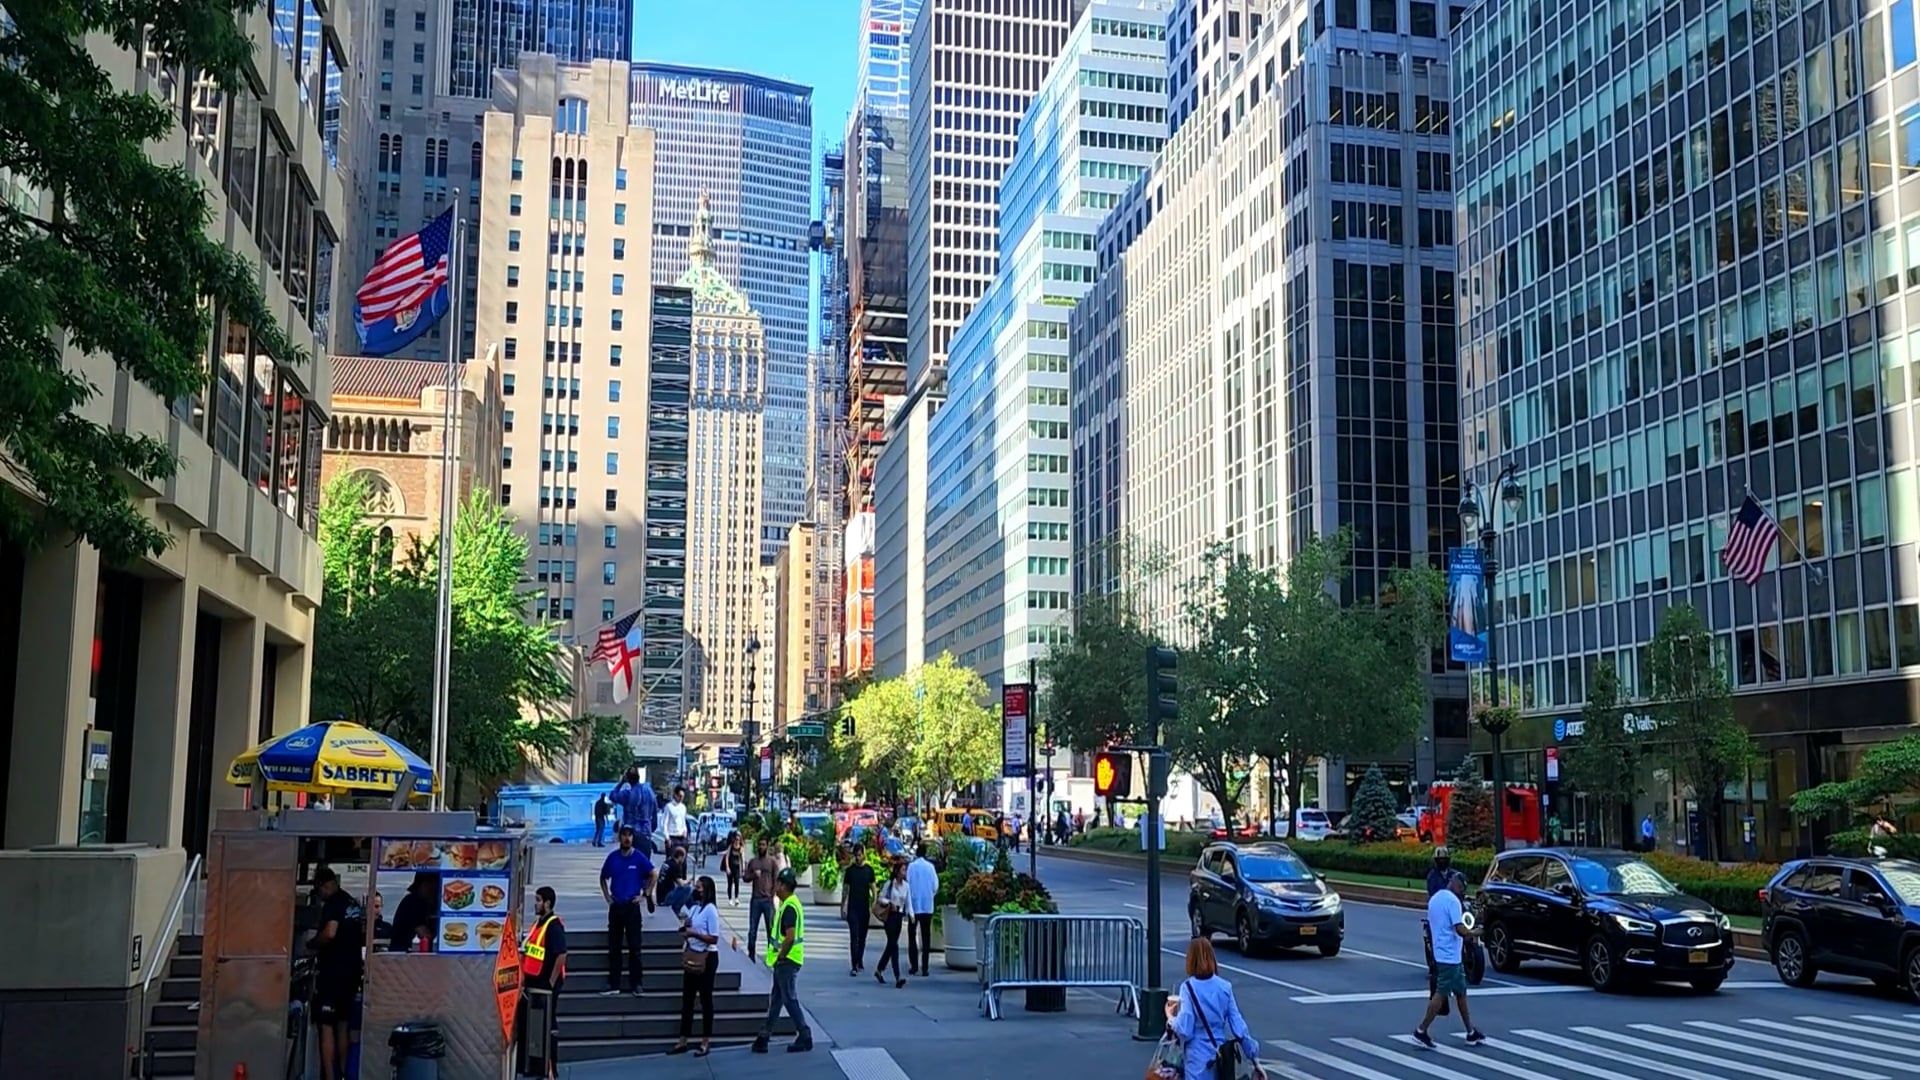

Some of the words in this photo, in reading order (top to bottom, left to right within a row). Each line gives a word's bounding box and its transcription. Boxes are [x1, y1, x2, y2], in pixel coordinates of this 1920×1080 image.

[659, 78, 730, 104] MetLife
[1566, 720, 1587, 737] AT&
[330, 739, 379, 749] SABRETT
[322, 764, 403, 785] SABRETT
